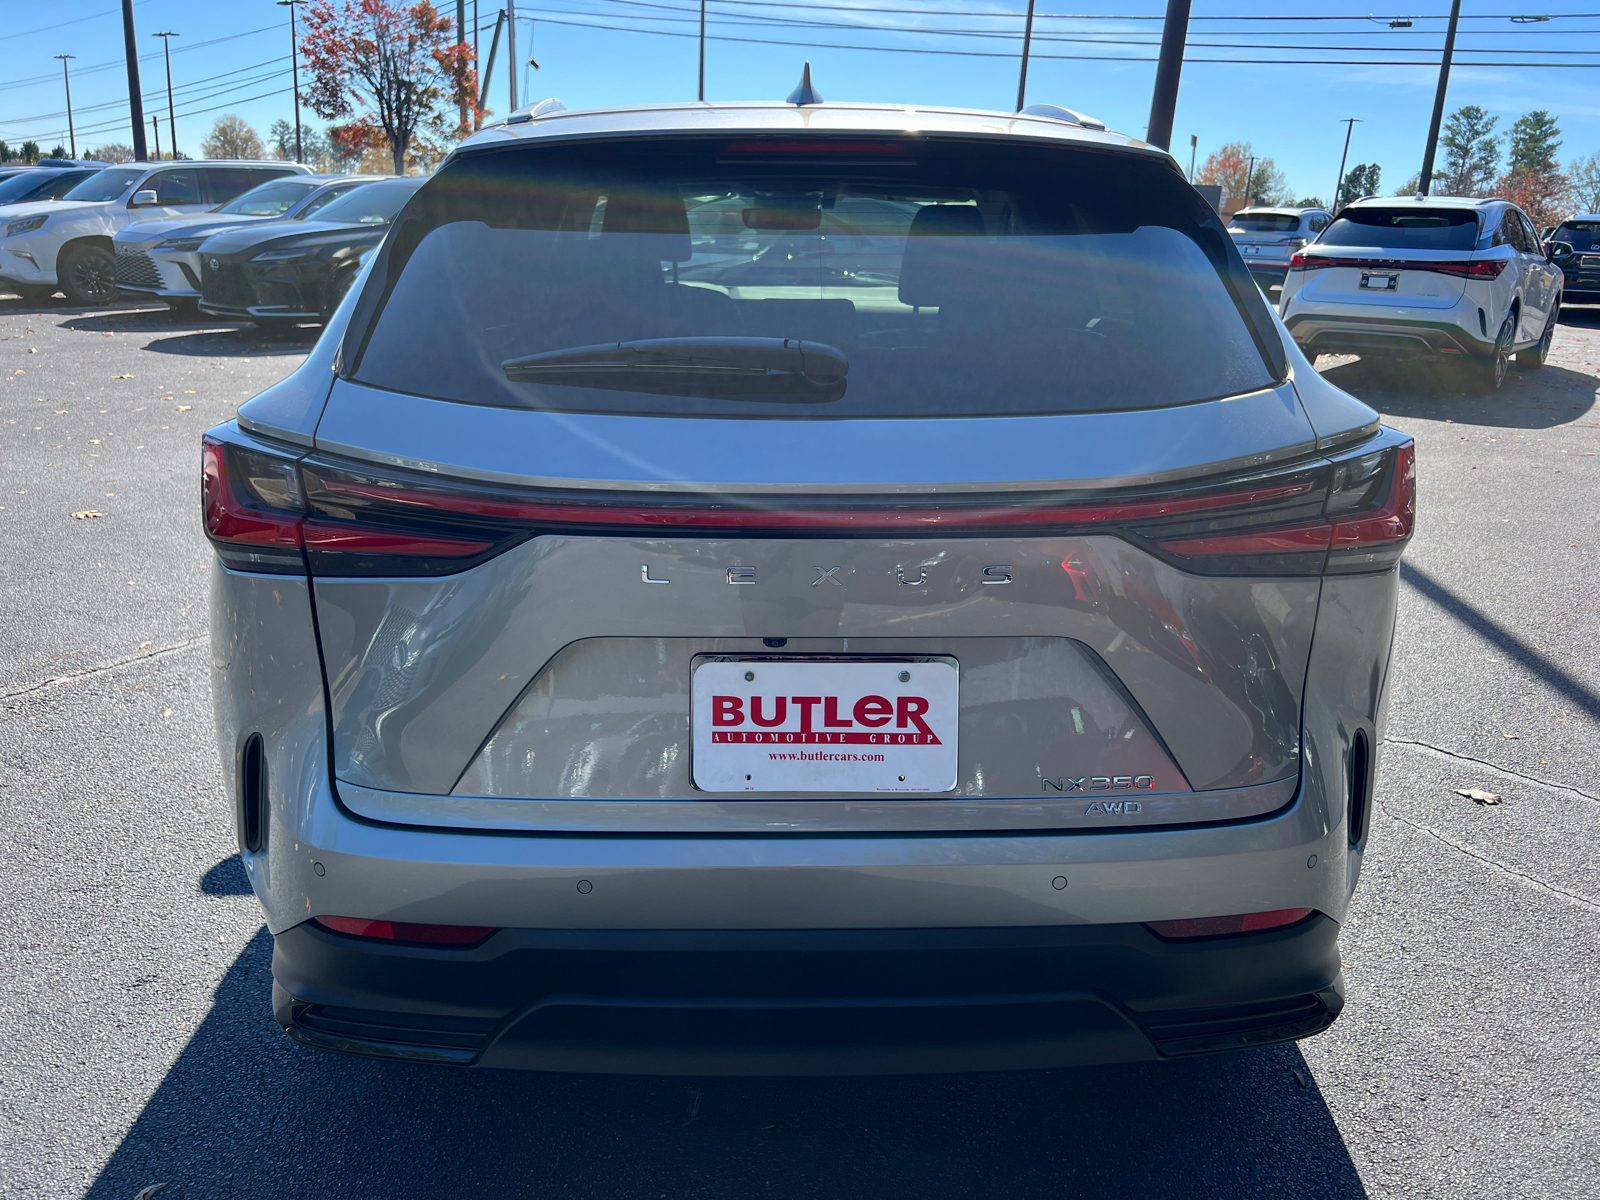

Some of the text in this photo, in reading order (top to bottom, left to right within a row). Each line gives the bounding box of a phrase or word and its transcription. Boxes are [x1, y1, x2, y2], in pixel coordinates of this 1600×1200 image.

[640, 564, 1013, 588] LEXUS
[713, 732, 934, 744] AUTOMOTIVE GROUP
[768, 750, 885, 762] www.butlercars.com
[1084, 801, 1142, 816] AWD
